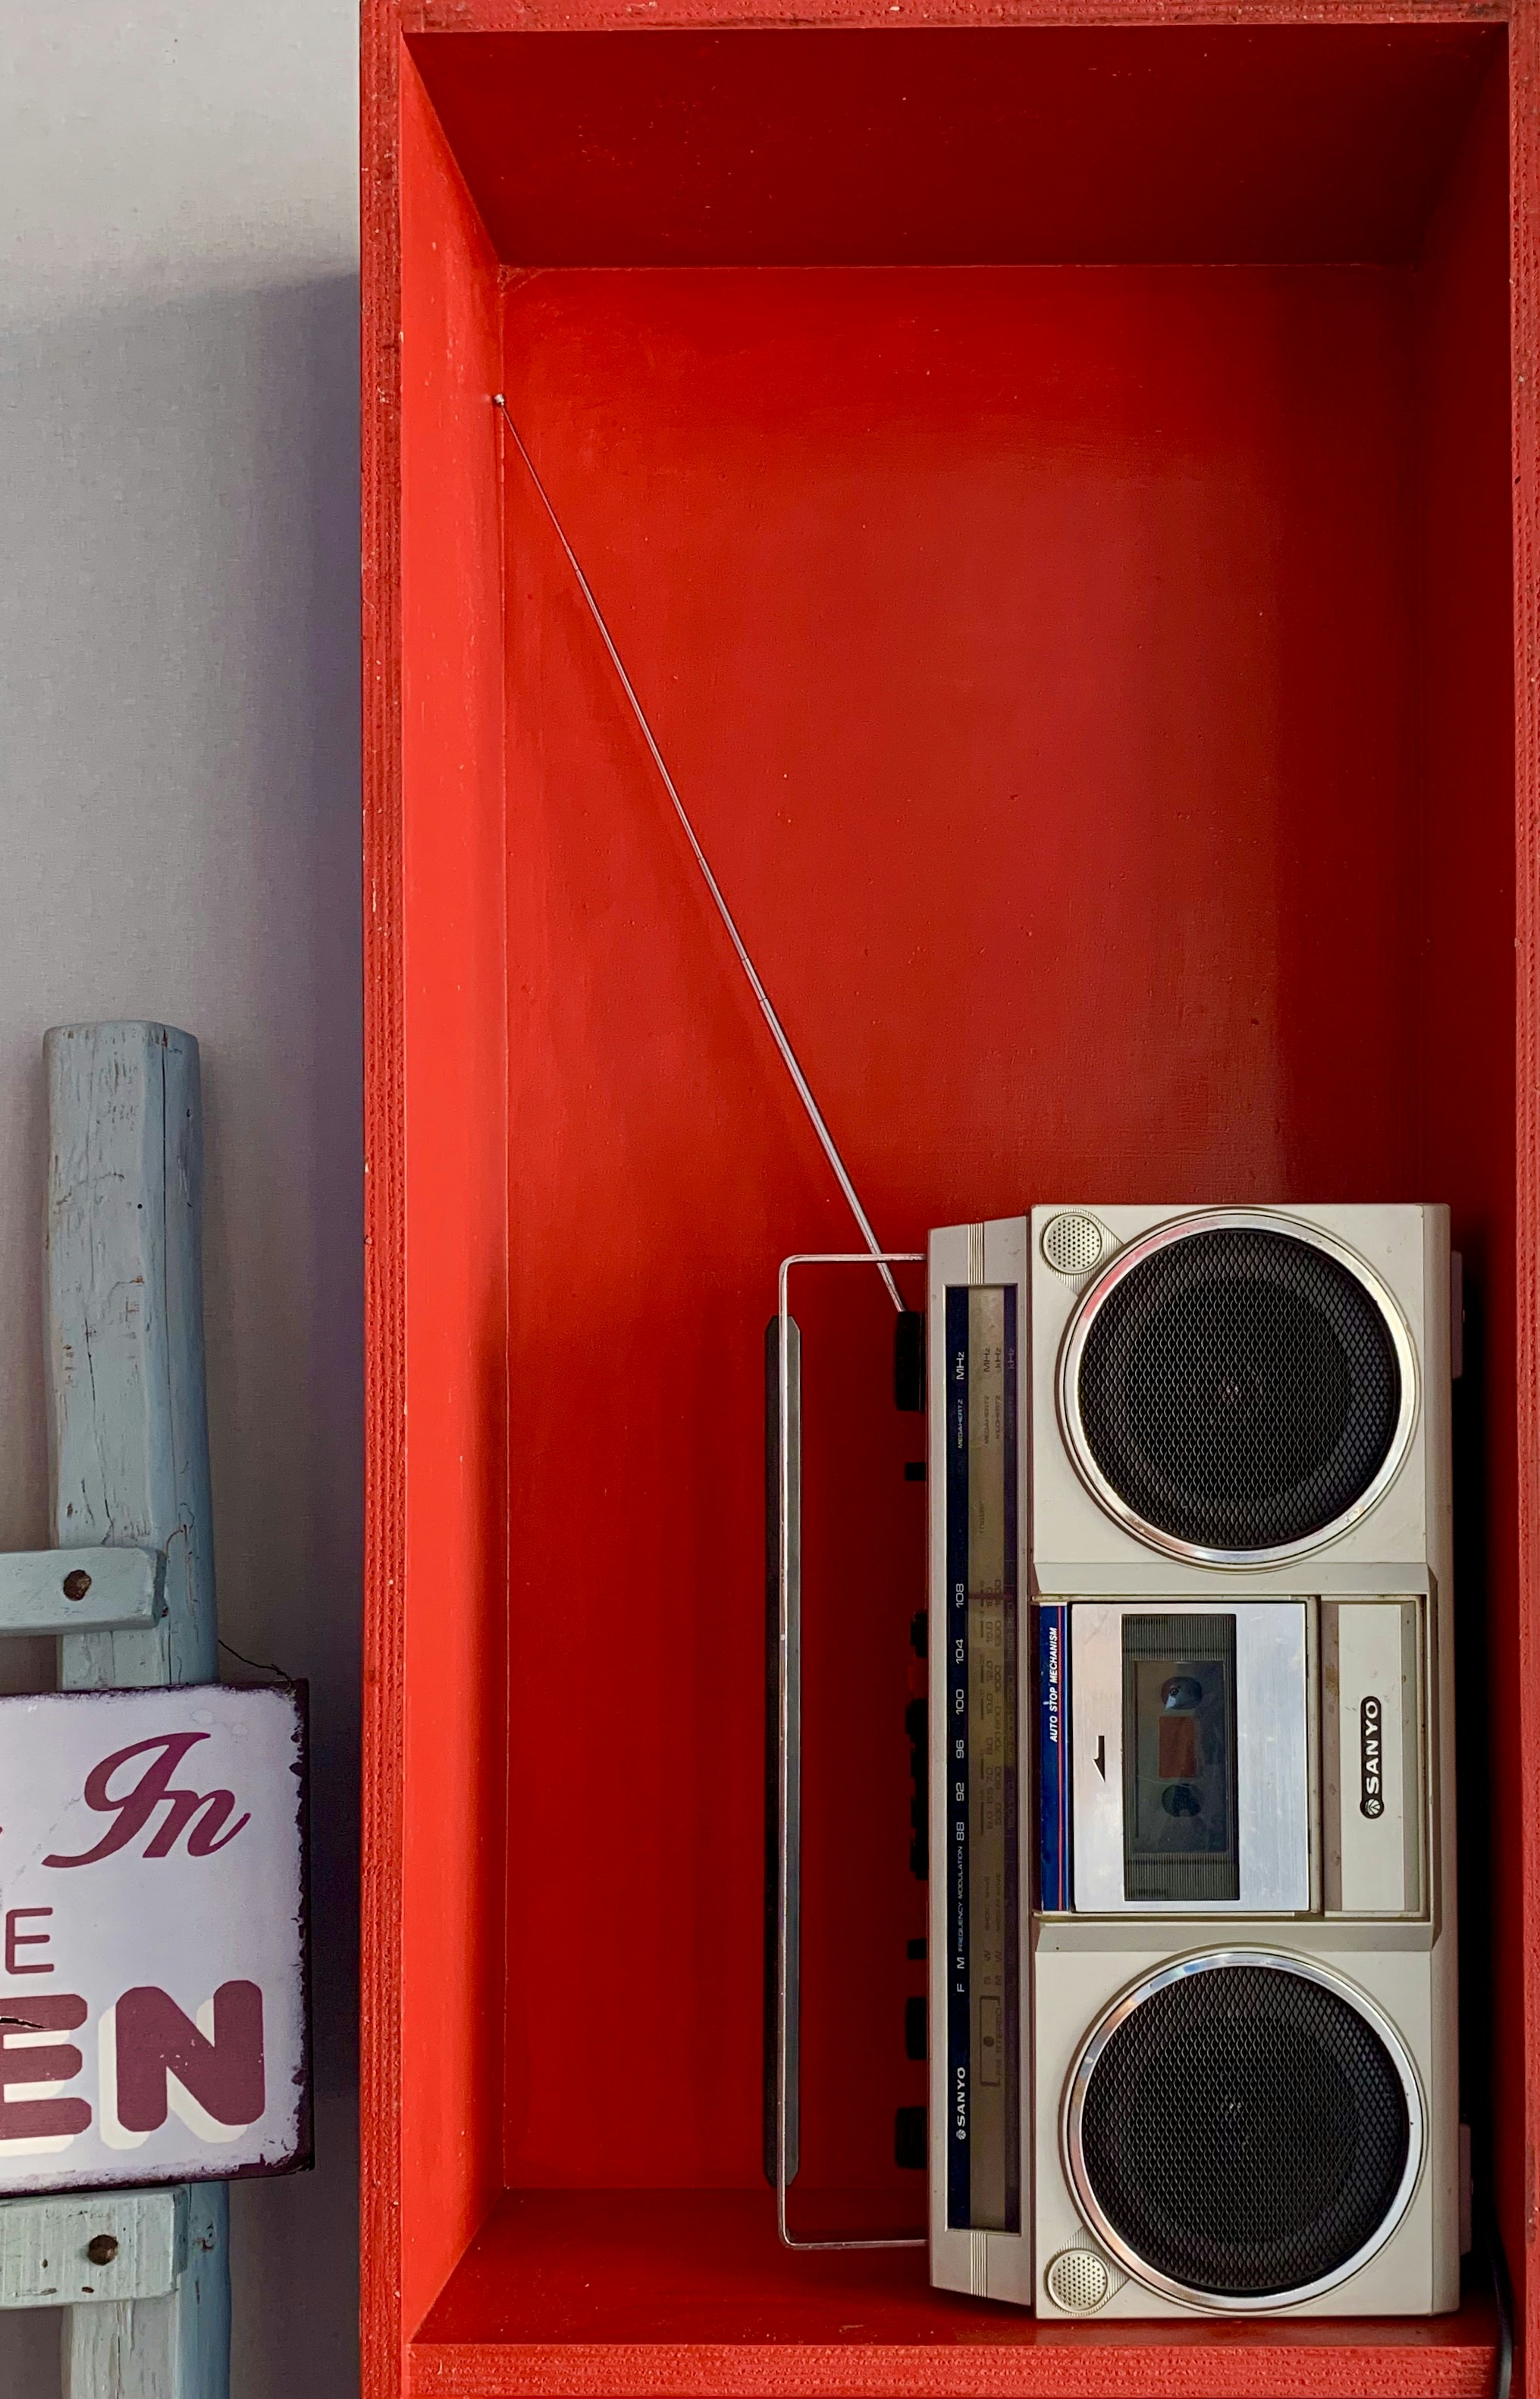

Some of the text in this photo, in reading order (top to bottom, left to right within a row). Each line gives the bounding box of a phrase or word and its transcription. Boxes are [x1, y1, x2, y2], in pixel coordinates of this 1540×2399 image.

[956, 1352, 964, 1380] MHz
[1049, 1627, 1058, 1742] AUTO STOP MECHANISM
[956, 1740, 964, 1758] 96
[1365, 1701, 1378, 1795] SANYO
[41, 1732, 251, 1868] In
[956, 1783, 964, 1802] 92
[956, 1822, 964, 1841] 88
[957, 1957, 964, 1968] M
[957, 1983, 964, 1992] F
[957, 2067, 965, 2127] SANYO
